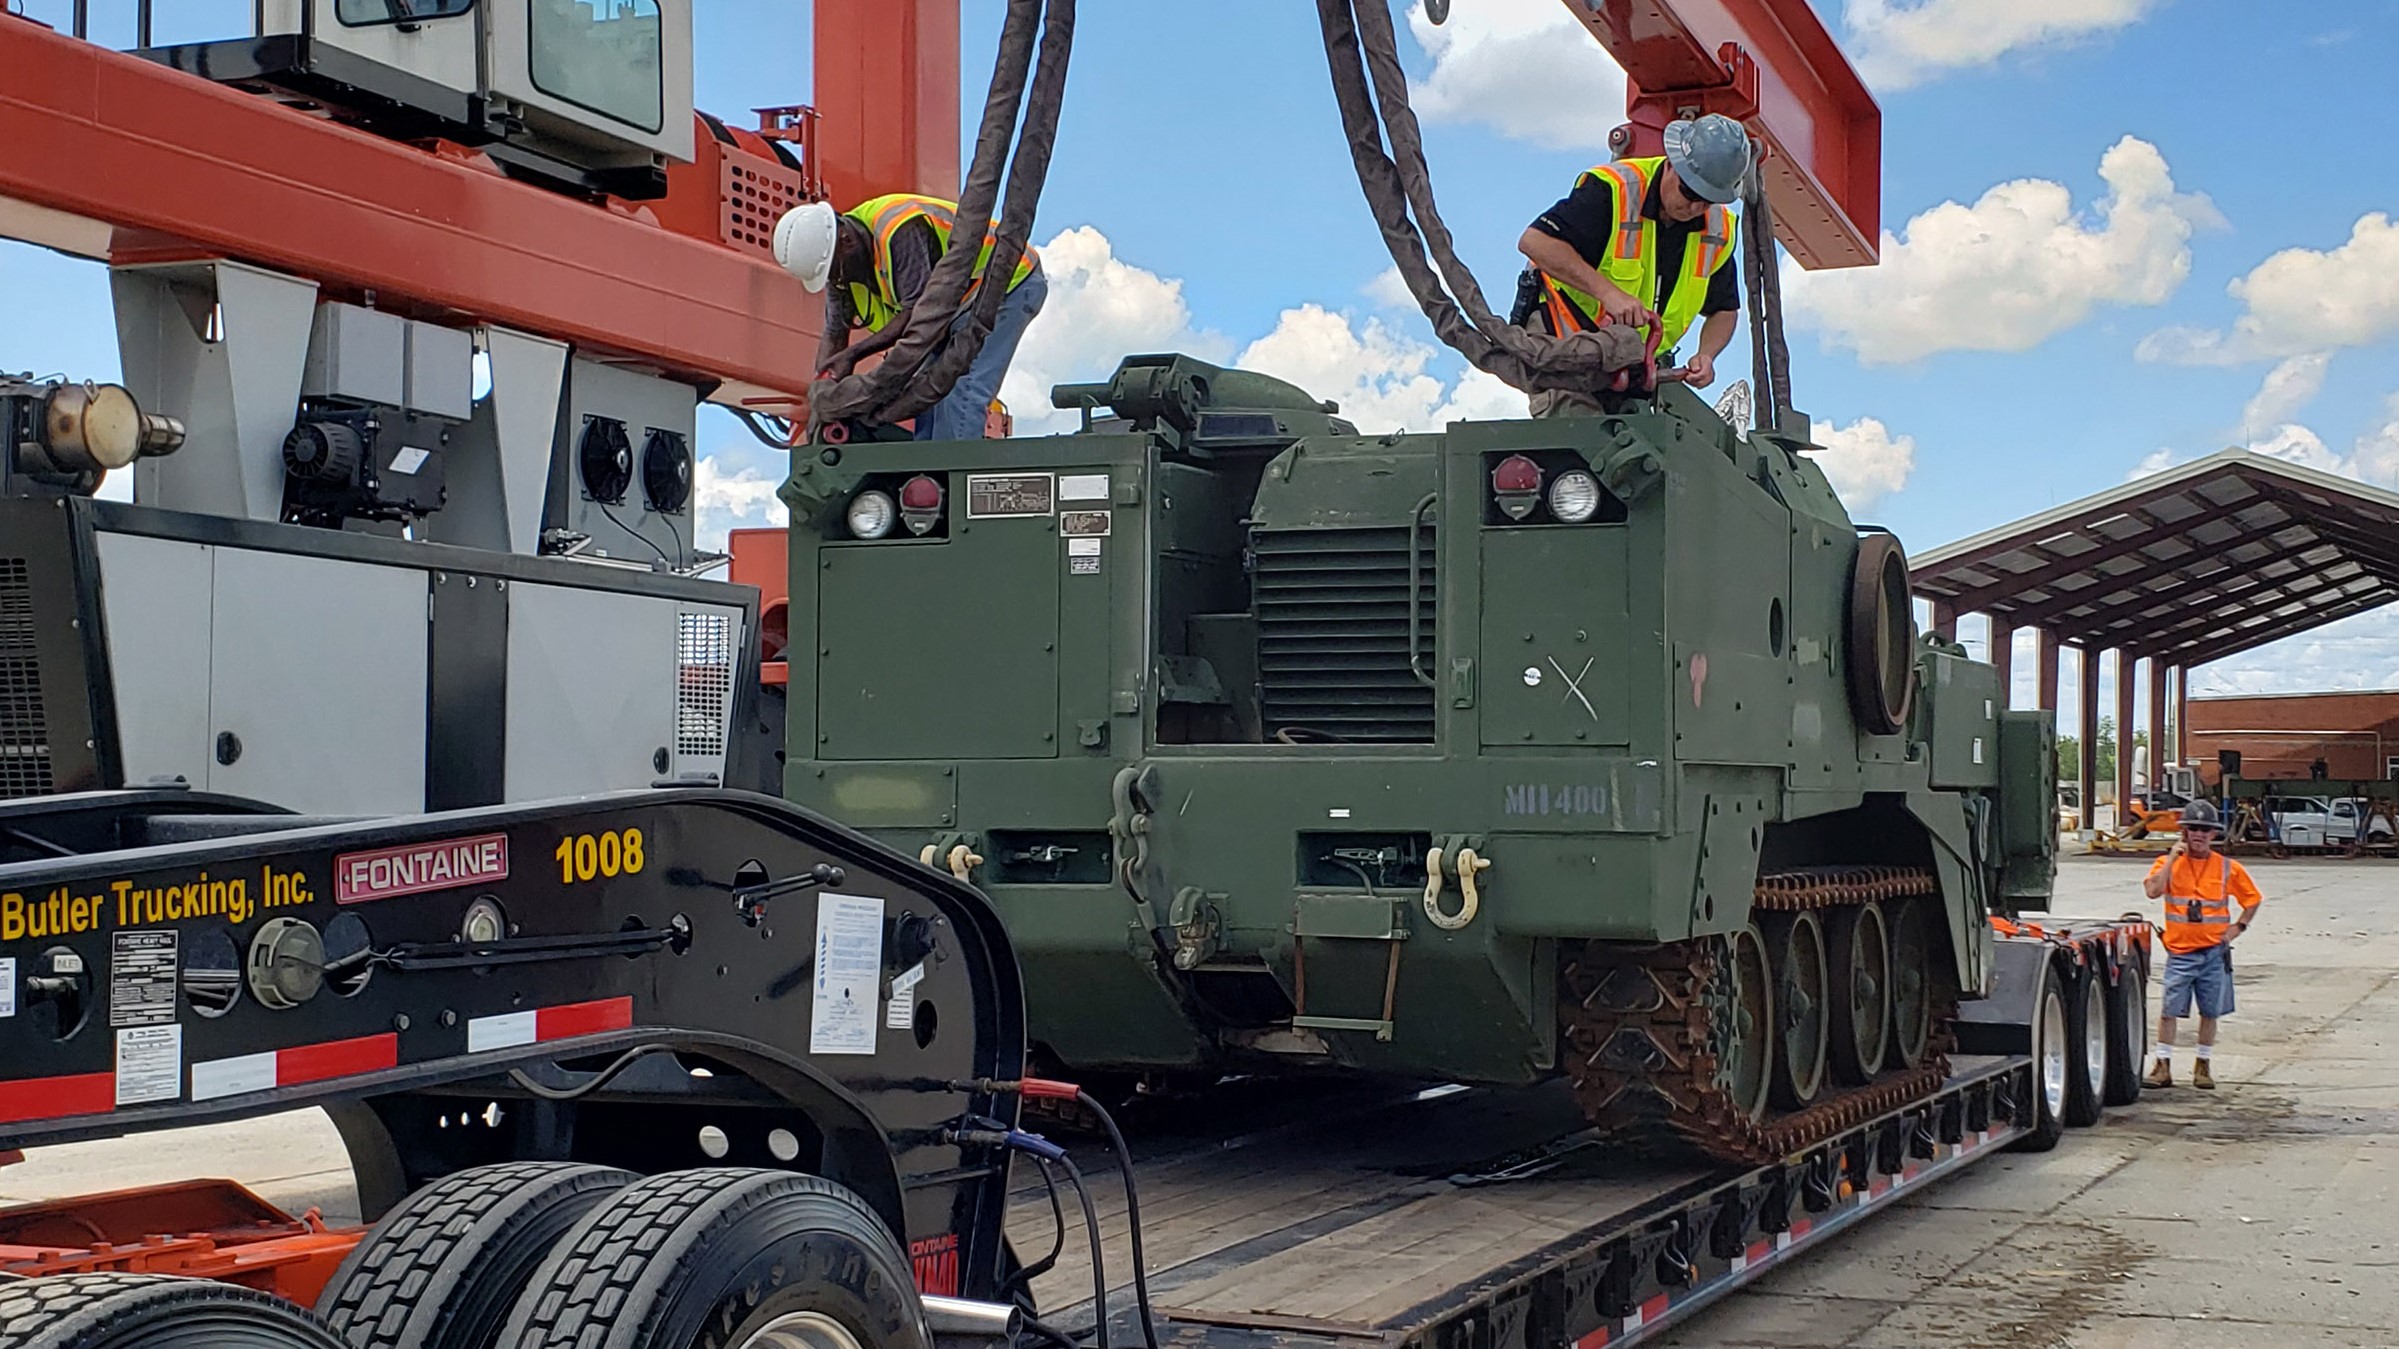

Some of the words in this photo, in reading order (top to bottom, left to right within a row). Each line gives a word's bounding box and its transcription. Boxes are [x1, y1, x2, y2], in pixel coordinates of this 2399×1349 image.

[350, 842, 499, 893] FONTAINE
[556, 828, 644, 884] 1008
[1, 886, 104, 941] Butler
[110, 872, 255, 925] Trucking,
[263, 863, 315, 908] Inc.
[911, 1233, 958, 1257] ONTAINE
